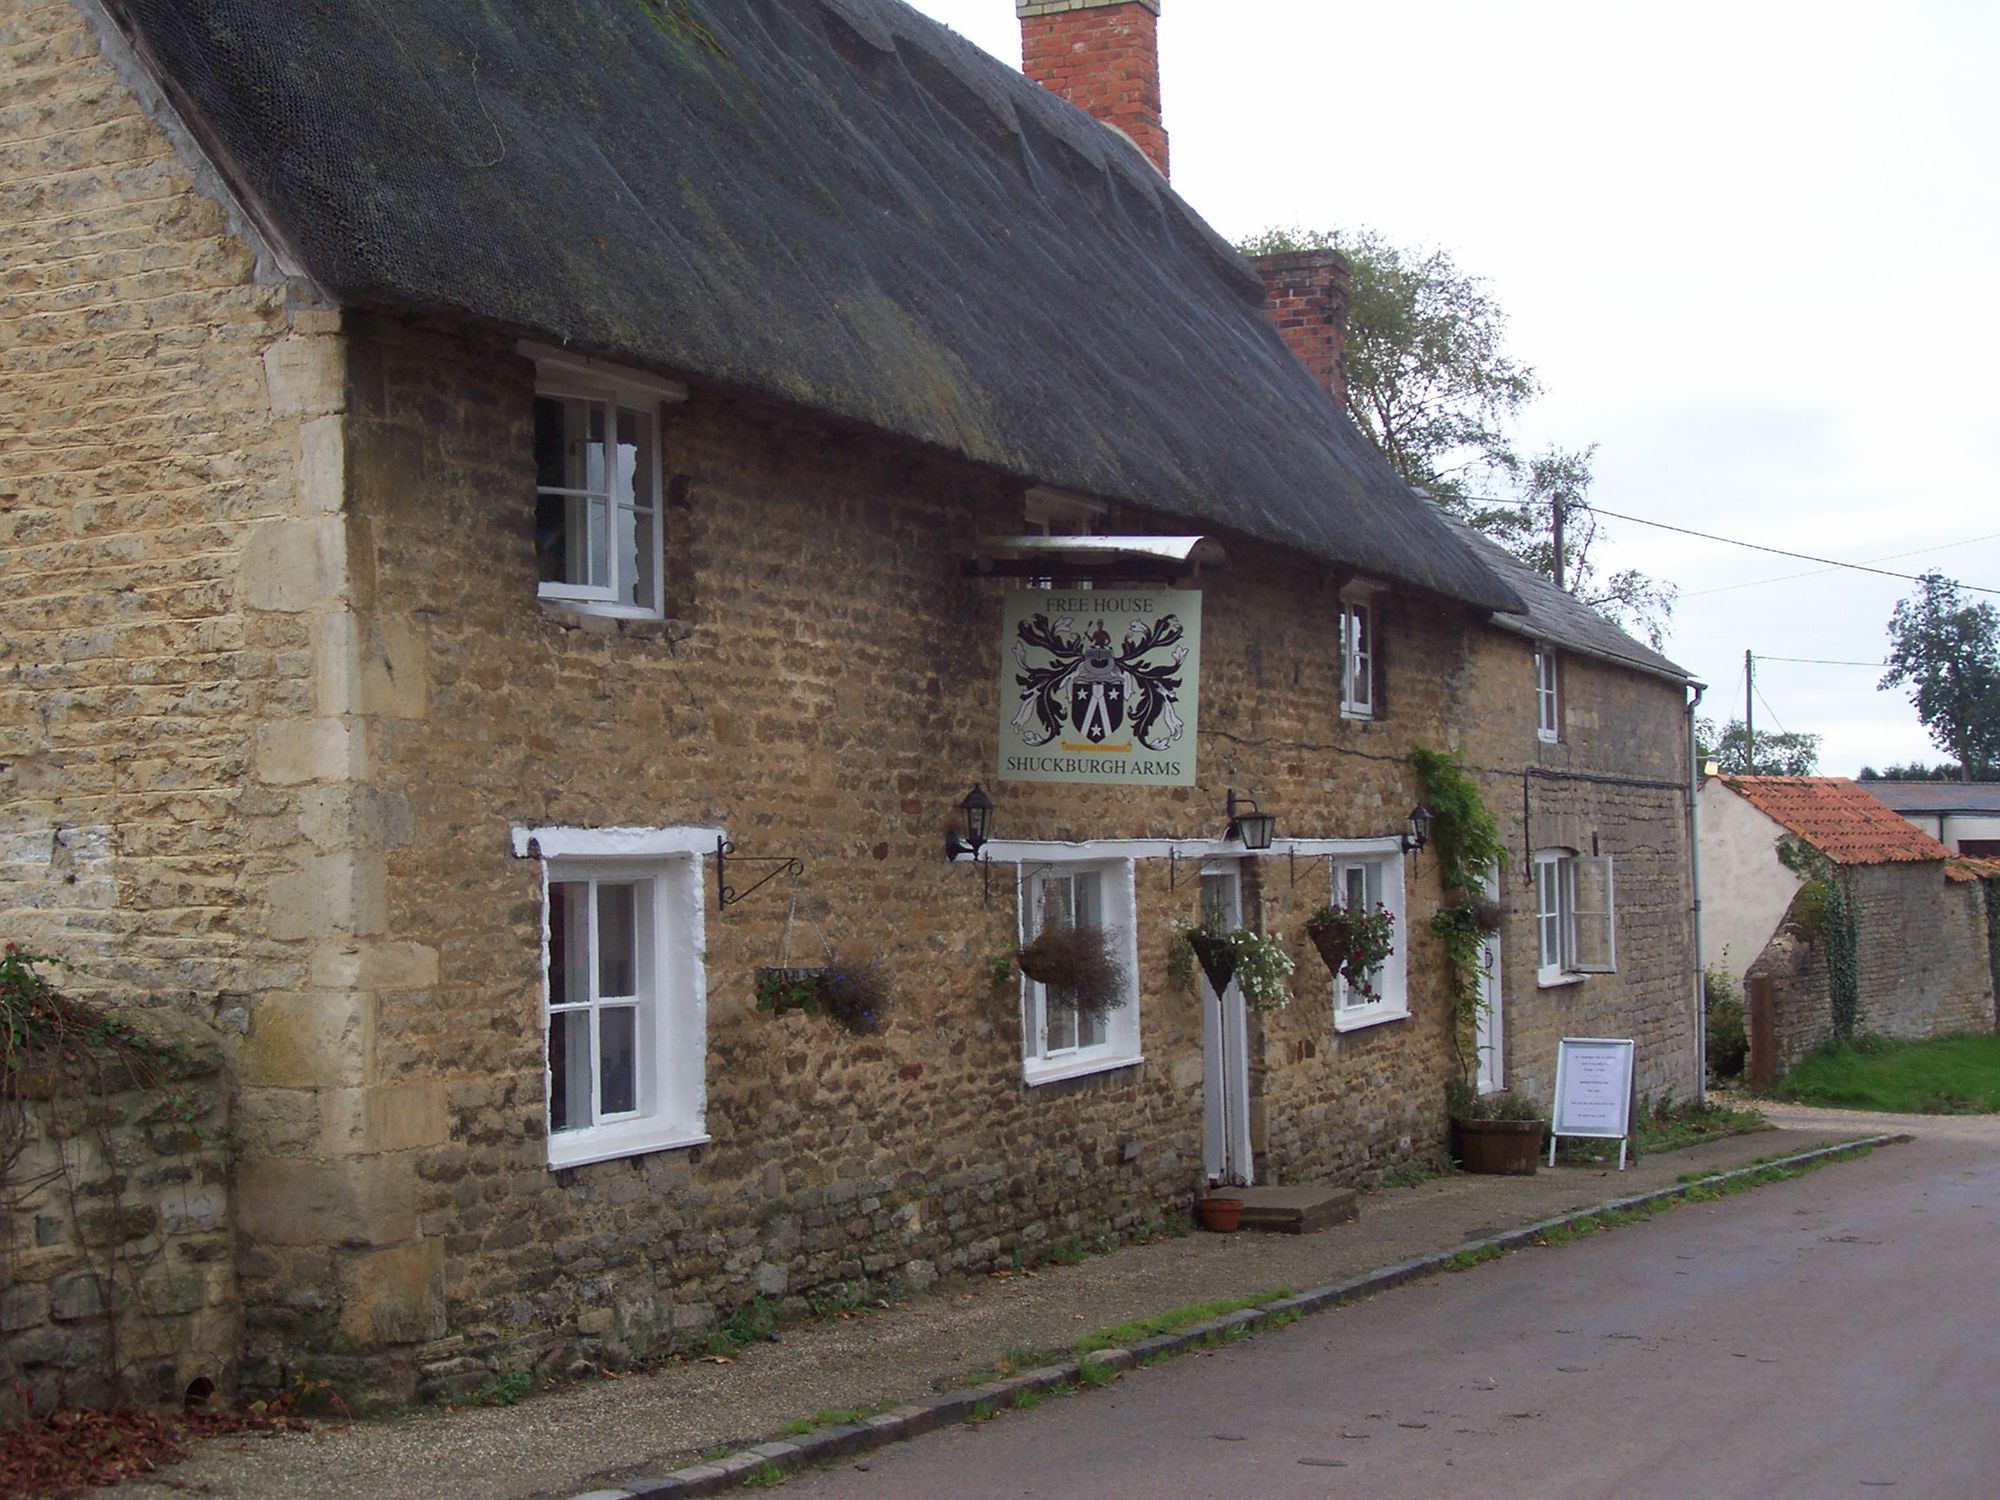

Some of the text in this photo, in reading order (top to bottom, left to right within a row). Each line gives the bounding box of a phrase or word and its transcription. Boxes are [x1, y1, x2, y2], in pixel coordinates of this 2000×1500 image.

[1046, 598, 1154, 613] FREE HOUSE
[1006, 757, 1181, 776] SHUCKBURGH ARMS
